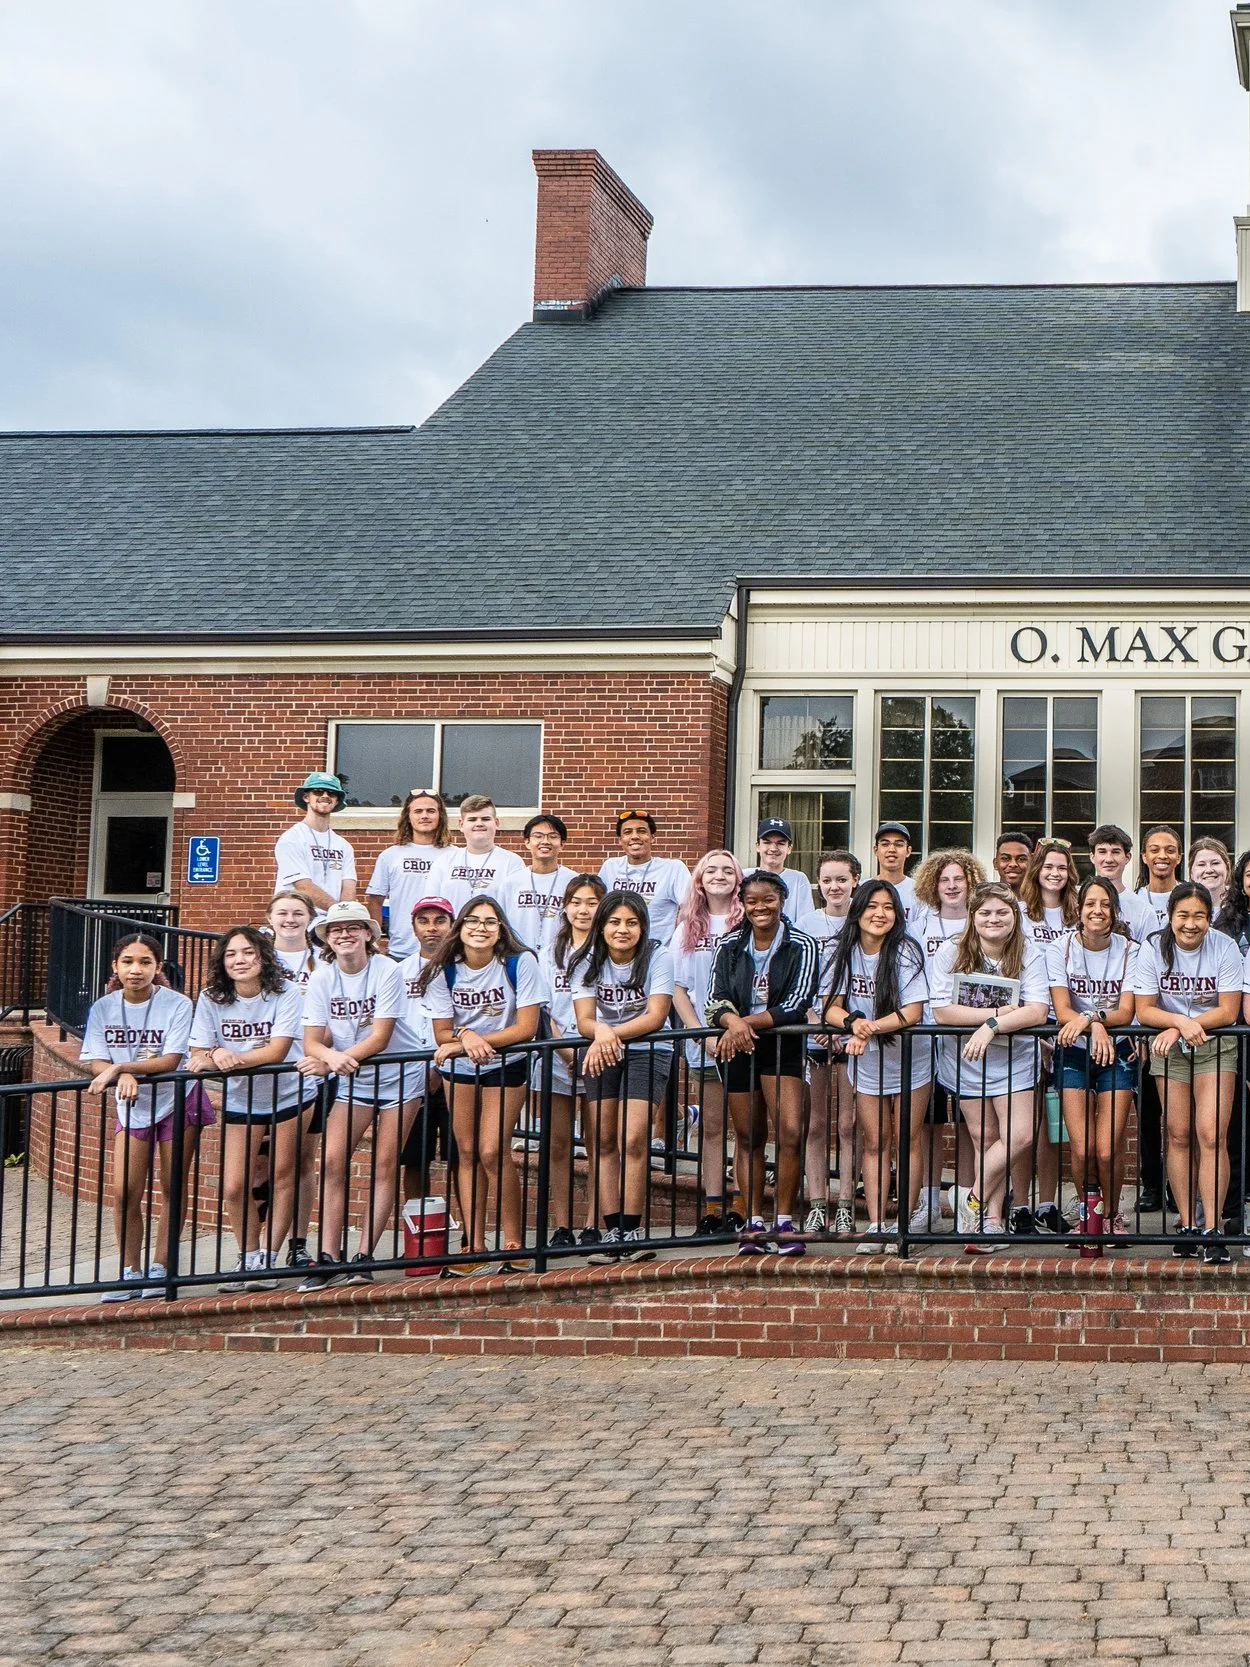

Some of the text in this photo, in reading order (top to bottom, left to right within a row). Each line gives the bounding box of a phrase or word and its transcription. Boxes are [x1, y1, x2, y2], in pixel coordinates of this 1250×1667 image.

[1010, 627, 1060, 664] O.
[1077, 627, 1198, 664] MAX
[451, 868, 496, 878] CROWN
[613, 881, 656, 893] CROWN
[518, 893, 563, 908] CROWN
[852, 978, 877, 994] CRO
[1069, 978, 1123, 995] CROWN
[1160, 976, 1217, 991] CROWN
[452, 986, 505, 1006] CROWN
[104, 1029, 164, 1044] CROWN
